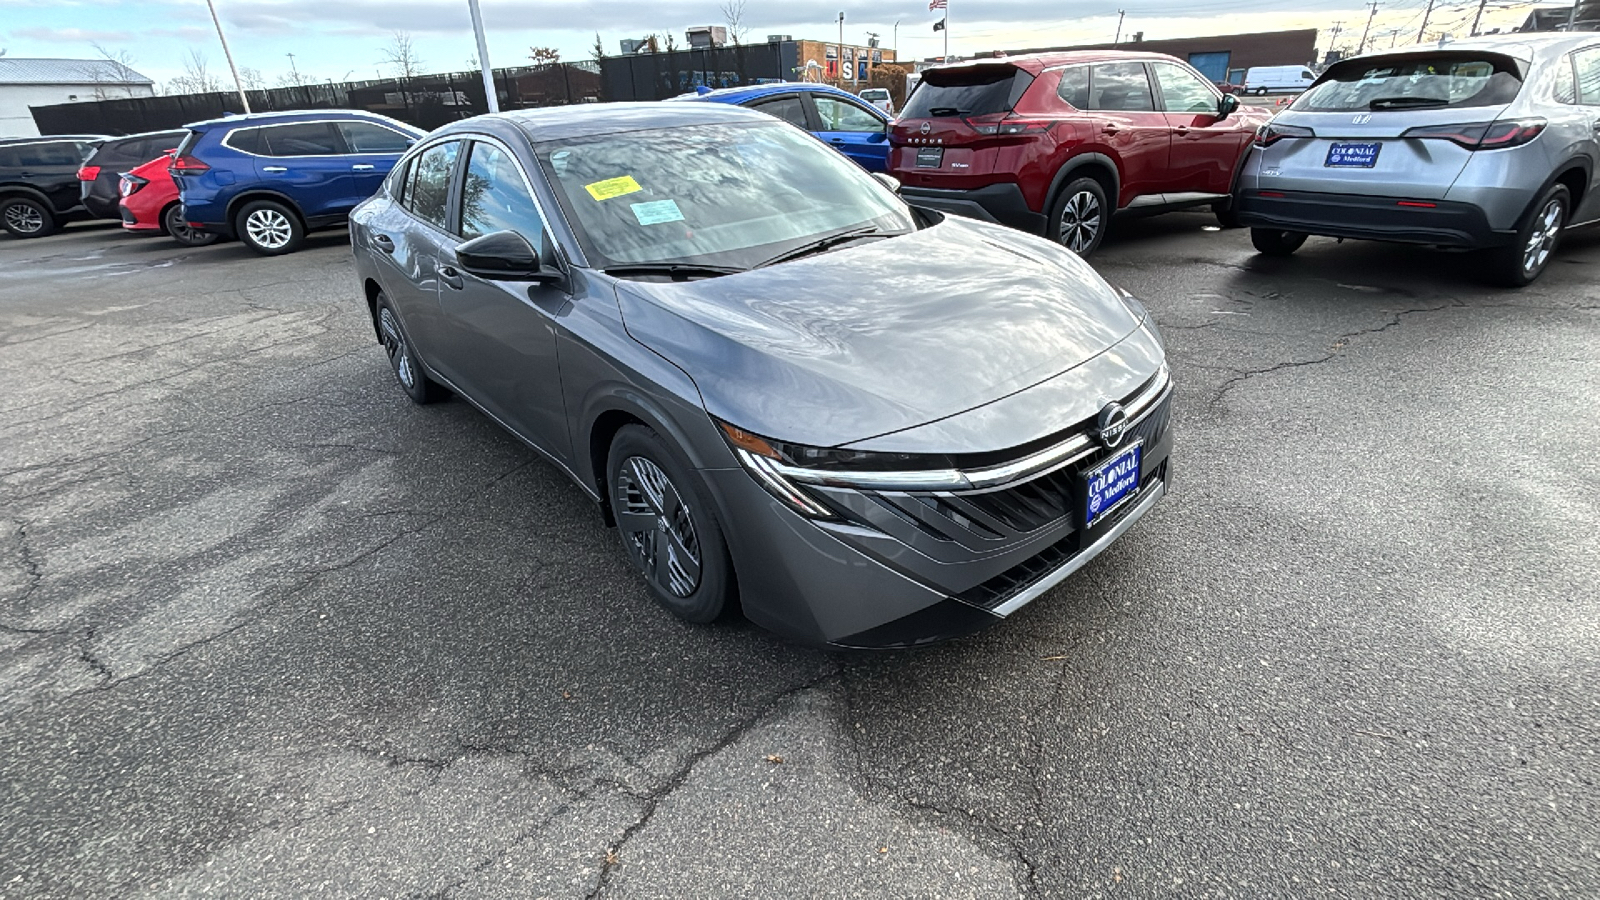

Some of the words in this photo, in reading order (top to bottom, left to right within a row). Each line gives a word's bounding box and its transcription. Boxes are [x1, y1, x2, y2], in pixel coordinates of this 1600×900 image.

[826, 61, 867, 80] USA
[1331, 147, 1376, 155] COLONIAL
[1088, 455, 1138, 498] COLONIAL
[1104, 472, 1135, 503] Medford
